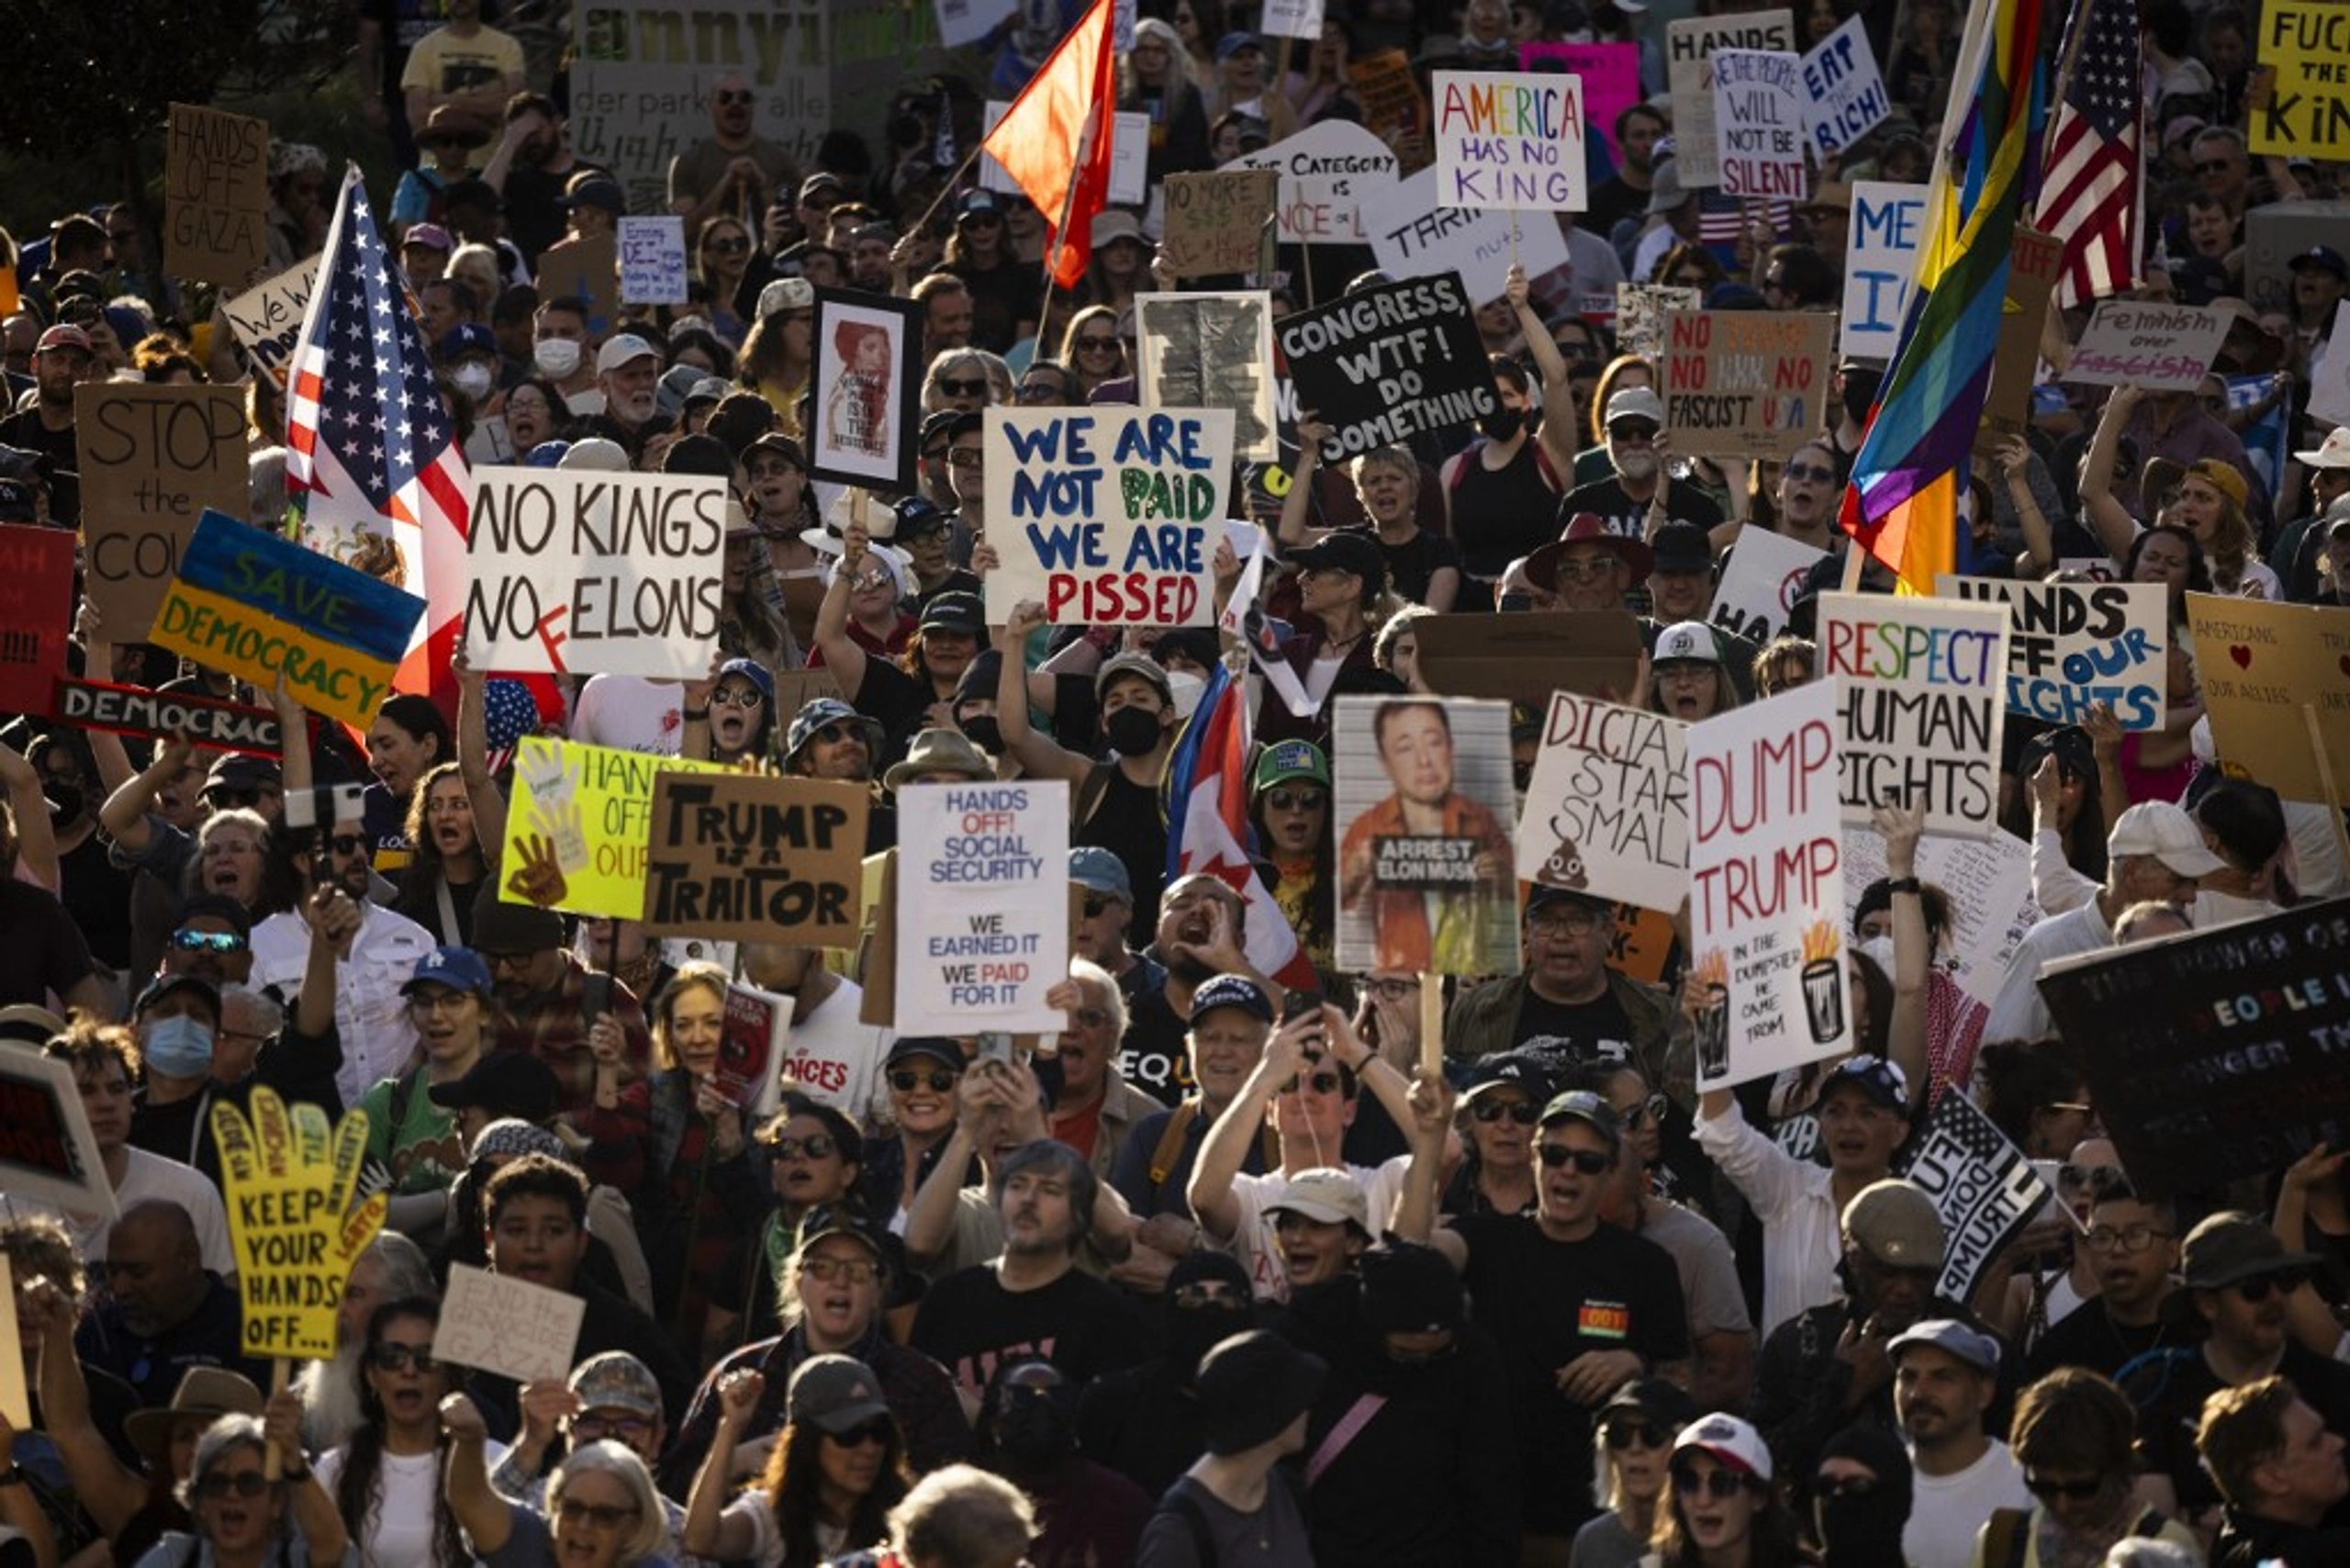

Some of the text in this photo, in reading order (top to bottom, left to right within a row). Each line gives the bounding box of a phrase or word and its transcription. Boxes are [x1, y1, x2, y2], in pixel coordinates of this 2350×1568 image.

[2273, 12, 2350, 52] FUC
[1803, 35, 1854, 101] EAT
[2301, 62, 2347, 84] THE
[1441, 82, 1580, 140] AMERICA
[1727, 91, 1783, 125] WILL
[1815, 79, 1888, 150] RICH!
[2266, 90, 2350, 144] KiN
[174, 111, 260, 163] HANDS
[1461, 138, 1558, 165] HAS NO
[1726, 129, 1795, 152] NOT BE
[186, 157, 249, 206] OFF
[1292, 153, 1393, 175] CATEGORY
[1724, 159, 1804, 196] SILENT
[1332, 181, 1350, 196] IS
[1455, 167, 1568, 202] KING
[174, 205, 256, 258] GAZA
[1282, 279, 1466, 358] CONGRESS,
[1673, 315, 1711, 351] NO
[2094, 303, 2217, 332] Feminism
[1336, 326, 1453, 385] WTF!
[2131, 334, 2177, 349] over
[1671, 354, 1707, 389] NO
[1775, 356, 1811, 389] NO
[2068, 348, 2205, 381] Fascism
[1378, 369, 1423, 406] DO
[1322, 386, 1495, 461] SOMETHING
[1666, 395, 1753, 429] FASCIST
[89, 398, 244, 472] STOP
[1002, 413, 1212, 469] WE ARE
[133, 479, 191, 516] the
[1012, 467, 1215, 521] NOT PAID
[466, 483, 723, 557] NO KINGS
[1026, 522, 1204, 573] WE ARE
[223, 550, 355, 635] SAVE
[463, 576, 540, 643] NO
[1047, 573, 1198, 624] PISSED
[161, 593, 384, 715] DEMOCRACY
[1827, 619, 1999, 687] RESPECT
[2063, 627, 2162, 685] OUR
[63, 687, 278, 745] DEMOCRAC
[1695, 719, 1833, 844] DUMP
[666, 784, 847, 849] TRUMP
[946, 790, 1029, 812] HANDS
[962, 812, 1015, 834] OFF!
[716, 846, 781, 866] IS A
[945, 836, 1030, 859] SOCIAL
[1381, 839, 1474, 861] ARREST
[930, 857, 1044, 883] SECURITY
[1377, 860, 1479, 881] ELON MUSK
[1694, 837, 1839, 935] TRUMP
[652, 861, 849, 926] TRAITOR
[969, 915, 1004, 935] WE
[929, 934, 1041, 957] EARNED IT
[1733, 931, 1781, 960] IN THE
[942, 962, 1030, 984] WE PAID
[1735, 948, 1801, 983] DUMPSTER
[951, 984, 1019, 1006] FOR IT
[240, 1189, 323, 1227] KEEP
[247, 1231, 329, 1267] YOUR
[248, 1273, 343, 1309] HANDS
